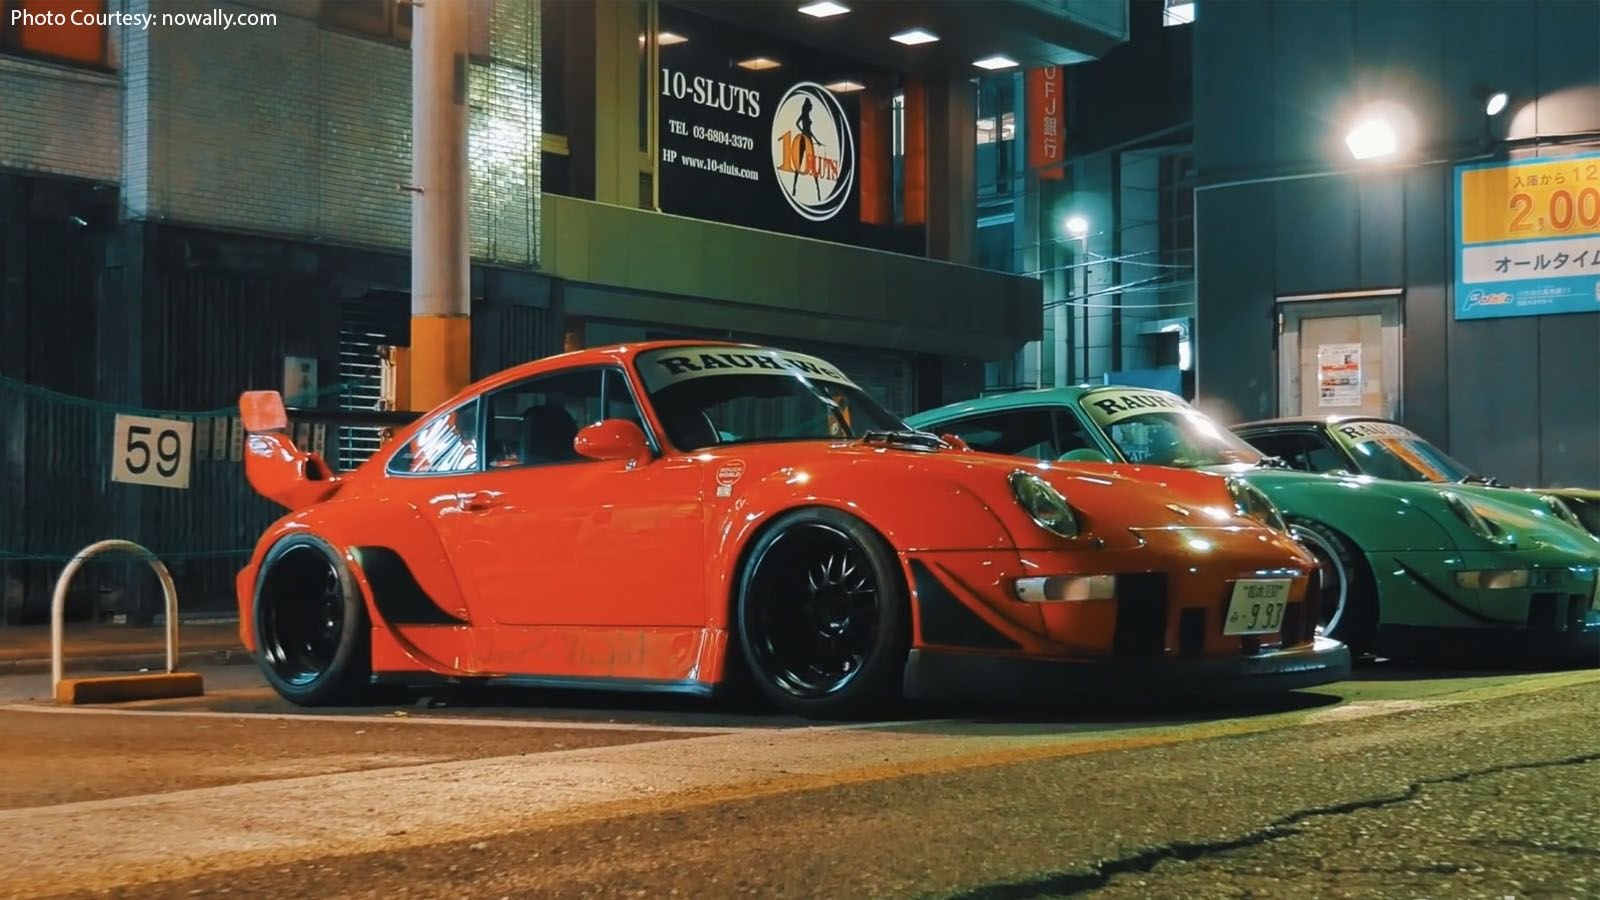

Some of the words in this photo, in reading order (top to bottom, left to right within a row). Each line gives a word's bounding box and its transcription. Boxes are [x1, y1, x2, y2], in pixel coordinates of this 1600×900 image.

[661, 68, 761, 118] 10-SLUTS
[669, 119, 689, 136] TEL
[693, 125, 754, 151] 03-6804-3370
[662, 149, 677, 163] HP
[681, 154, 759, 181] www.10-sluts.com
[125, 425, 181, 478] 59
